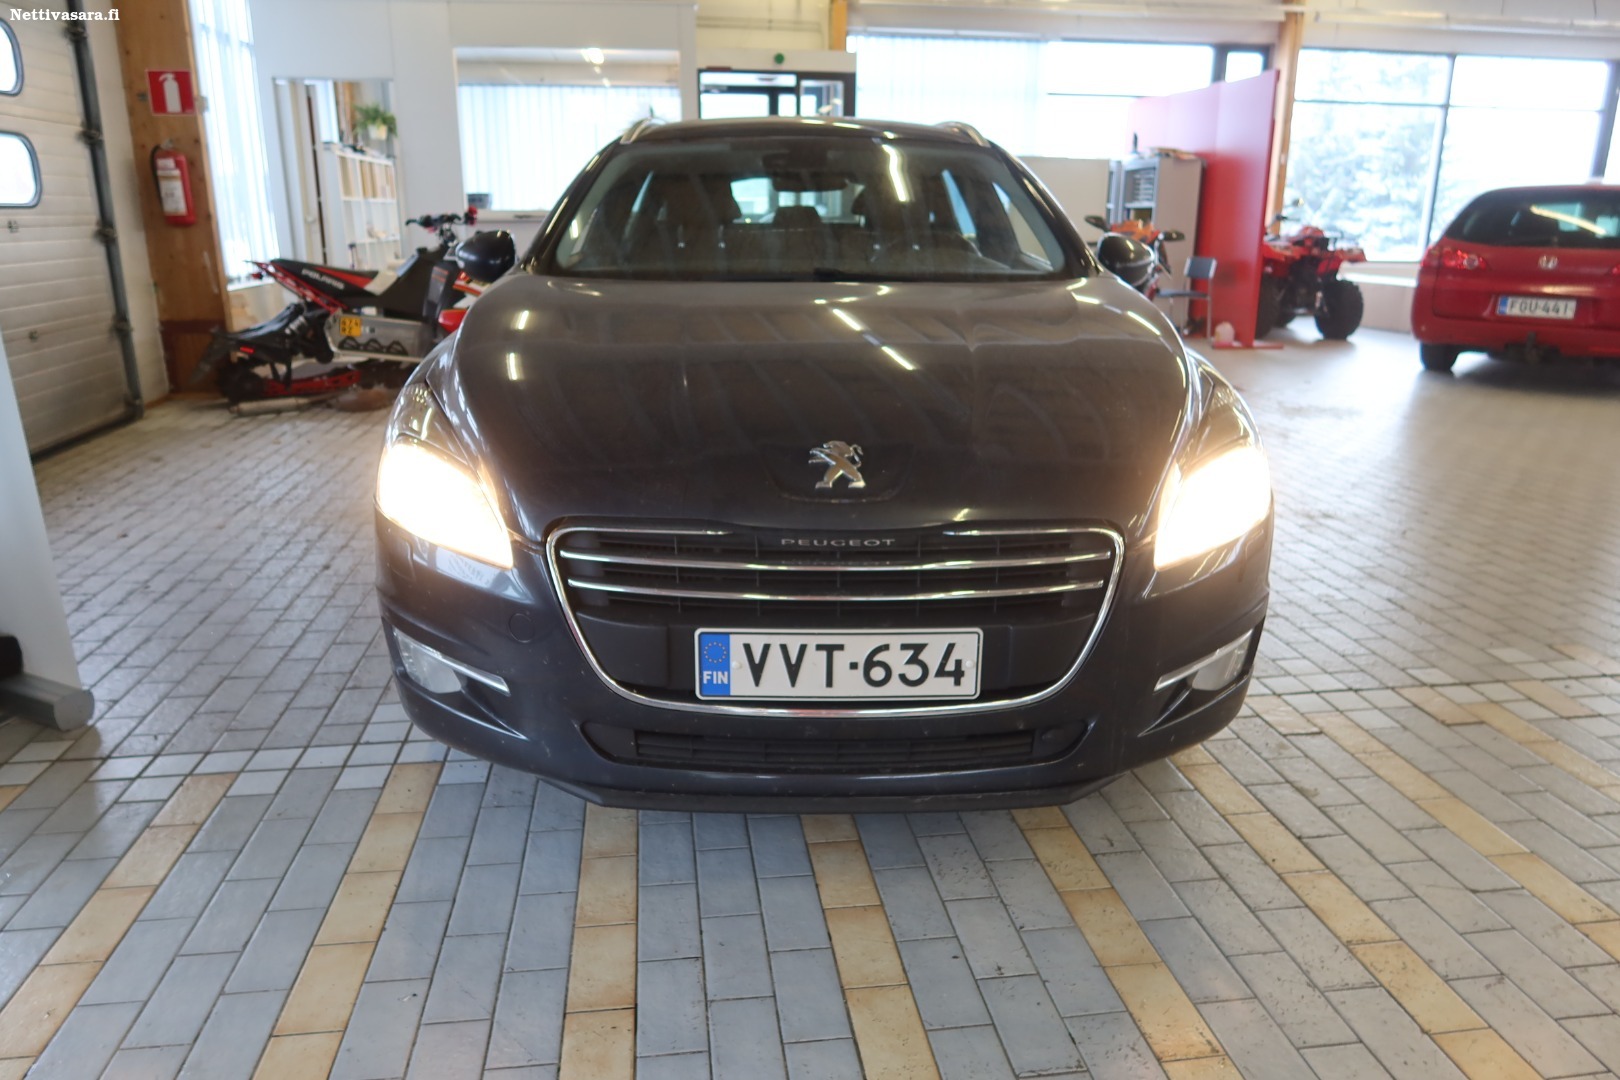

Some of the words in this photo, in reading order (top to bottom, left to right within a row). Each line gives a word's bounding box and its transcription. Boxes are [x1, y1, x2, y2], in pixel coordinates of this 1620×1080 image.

[302, 268, 345, 290] POLARIS
[781, 538, 896, 547] PEUGEOT
[742, 642, 965, 688] VVT-634
[703, 670, 728, 684] FIN
